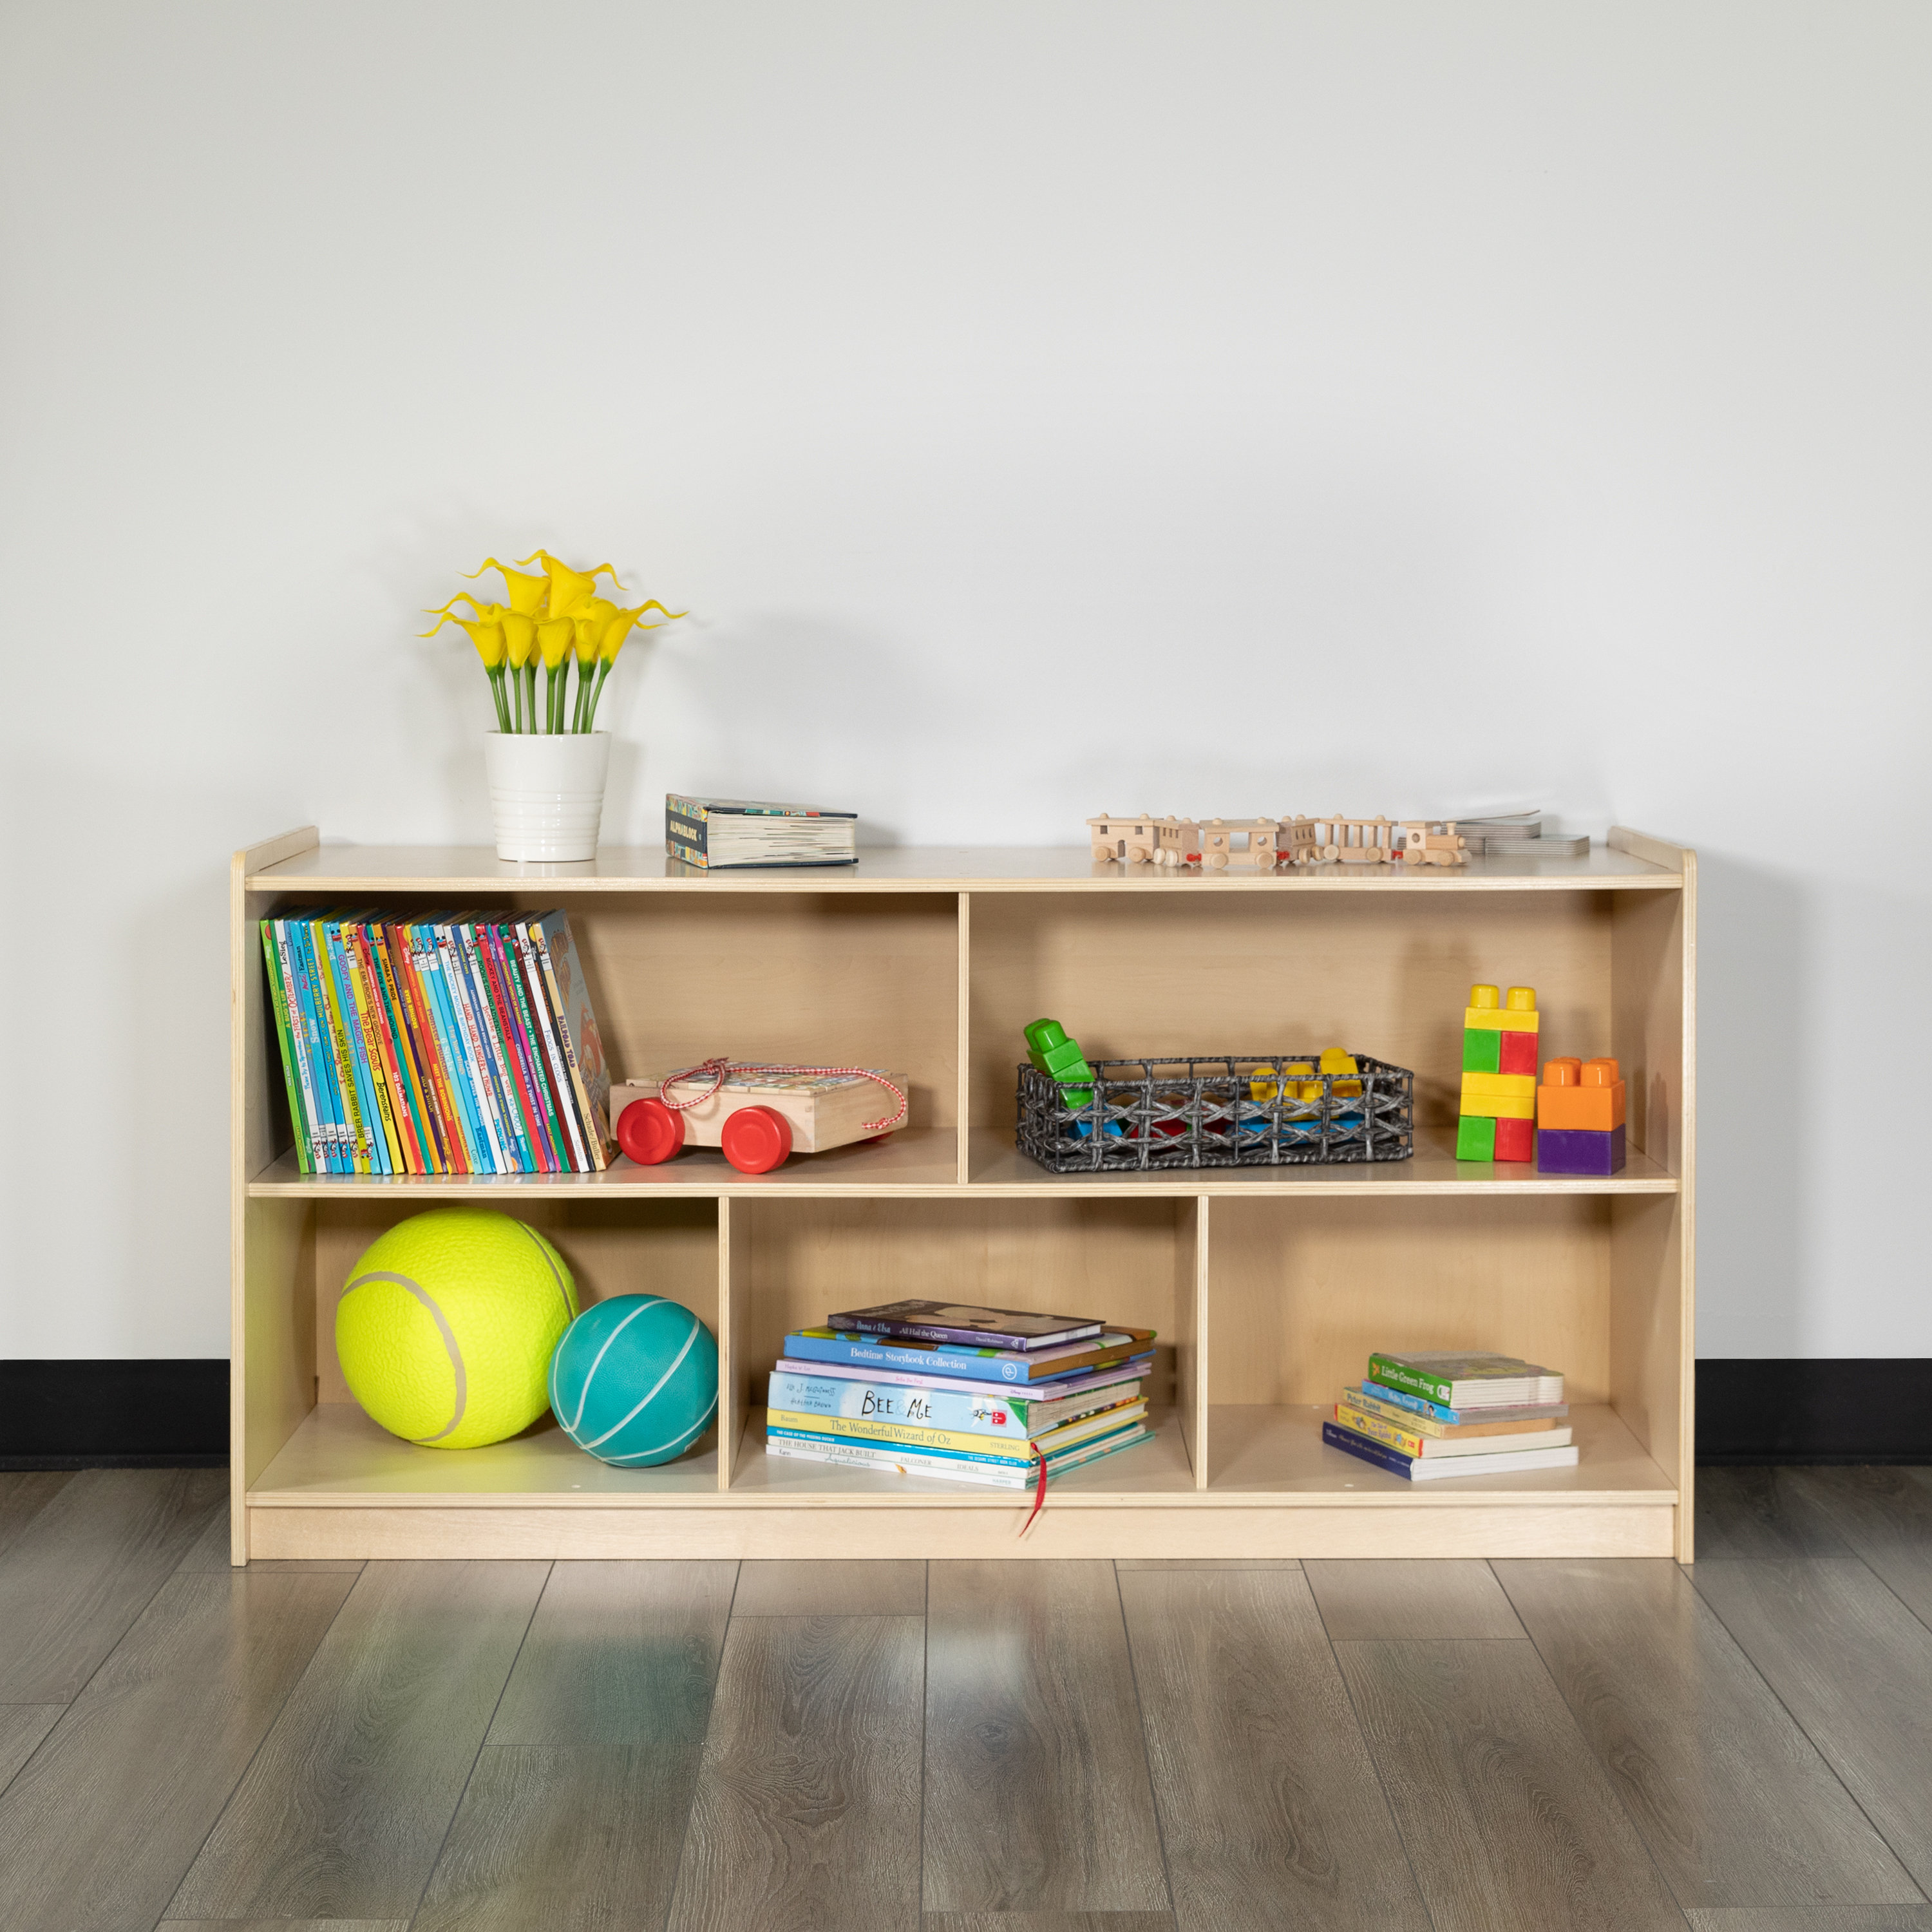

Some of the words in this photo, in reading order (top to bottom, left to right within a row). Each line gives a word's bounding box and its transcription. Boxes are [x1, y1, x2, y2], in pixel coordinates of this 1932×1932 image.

[670, 820, 697, 842] ALPHABLOCK
[279, 940, 290, 964] LeSieg
[325, 933, 333, 950] Seuss
[362, 945, 371, 964] Disney
[338, 954, 350, 980] GOOFY
[382, 958, 392, 981] SIMBA'S
[344, 984, 354, 999] AND
[477, 960, 488, 983] POOH'S
[484, 985, 494, 1007] GRAND
[490, 1009, 504, 1043] ADVENTURE
[486, 958, 495, 978] MICKEY
[498, 1007, 511, 1040] BEANSTALK
[349, 1001, 357, 1016] THE
[360, 971, 373, 1004] EMPEROR'S
[373, 1021, 383, 1045] GROOVE
[361, 1010, 371, 1026] The
[408, 1005, 418, 1028] BROTHER
[448, 973, 457, 993] MICKEY
[453, 996, 462, 1016] MOUSE
[459, 1017, 470, 1045] BIRTHDAY
[482, 1005, 495, 1031] Because
[308, 1019, 319, 1043] Snow
[337, 1029, 346, 1046] SKIN
[352, 1019, 363, 1044] MAGIC
[363, 1028, 375, 1046] Bear
[387, 1016, 397, 1039] HOUND
[510, 960, 520, 982] BEAUTY
[522, 1010, 532, 1028] BEAST
[532, 1046, 545, 1081] ENCHANTED
[541, 1083, 554, 1116] CHRISTMAS
[427, 1009, 440, 1041] Monster
[437, 1044, 450, 1080] Munchies
[493, 1041, 503, 1060] Little
[557, 1016, 570, 1048] RAILROAD
[567, 1050, 575, 1068] TOAD
[358, 1046, 368, 1063] FISH
[368, 1048, 381, 1070] Scouts
[442, 1045, 453, 1071] Sticks
[457, 1055, 465, 1074] Wings
[516, 1044, 527, 1074] CINDERELLA
[544, 1030, 553, 1050] FROGS
[553, 1063, 563, 1082] CLOGS
[344, 1063, 354, 1087] SAVES
[496, 1063, 508, 1076] Bug
[349, 1090, 360, 1116] RABBIT
[376, 1082, 392, 1121] Berenstains
[395, 1083, 408, 1117] DALMATIANS
[439, 1089, 452, 1121] ROBINSONS
[355, 1118, 365, 1138] BRER
[493, 1119, 507, 1150] PERKINS
[583, 1113, 600, 1159] Schade/Buller
[475, 1128, 487, 1158] Eastman
[471, 1150, 479, 1164] Coxe
[857, 1321, 872, 1331] Anna
[878, 1322, 891, 1333] Elsa
[909, 1327, 920, 1336] Hail
[921, 1329, 929, 1337] the
[930, 1330, 948, 1340] Queen
[851, 1347, 884, 1360] Bedtime
[886, 1351, 924, 1365] Storybook
[926, 1356, 967, 1370] Collection
[1381, 1365, 1398, 1381] Little
[1399, 1372, 1419, 1387] Green
[1419, 1378, 1435, 1395] Frog
[862, 1390, 894, 1417] BEE
[907, 1397, 933, 1419] ME
[1347, 1392, 1362, 1406] Peter
[1363, 1399, 1381, 1414] Rabbit
[781, 1414, 798, 1423] Baum
[830, 1419, 846, 1431] The
[849, 1421, 893, 1437] Wonderful
[893, 1427, 924, 1442] Wizard
[927, 1431, 936, 1445] of
[938, 1433, 951, 1445] Oz
[793, 1440, 817, 1450] HOUSE
[819, 1443, 837, 1452] THAT
[837, 1446, 854, 1455] JACK
[855, 1448, 876, 1458] BUILT
[990, 1441, 1020, 1452] STERLING
[900, 1457, 932, 1466] FALCONER
